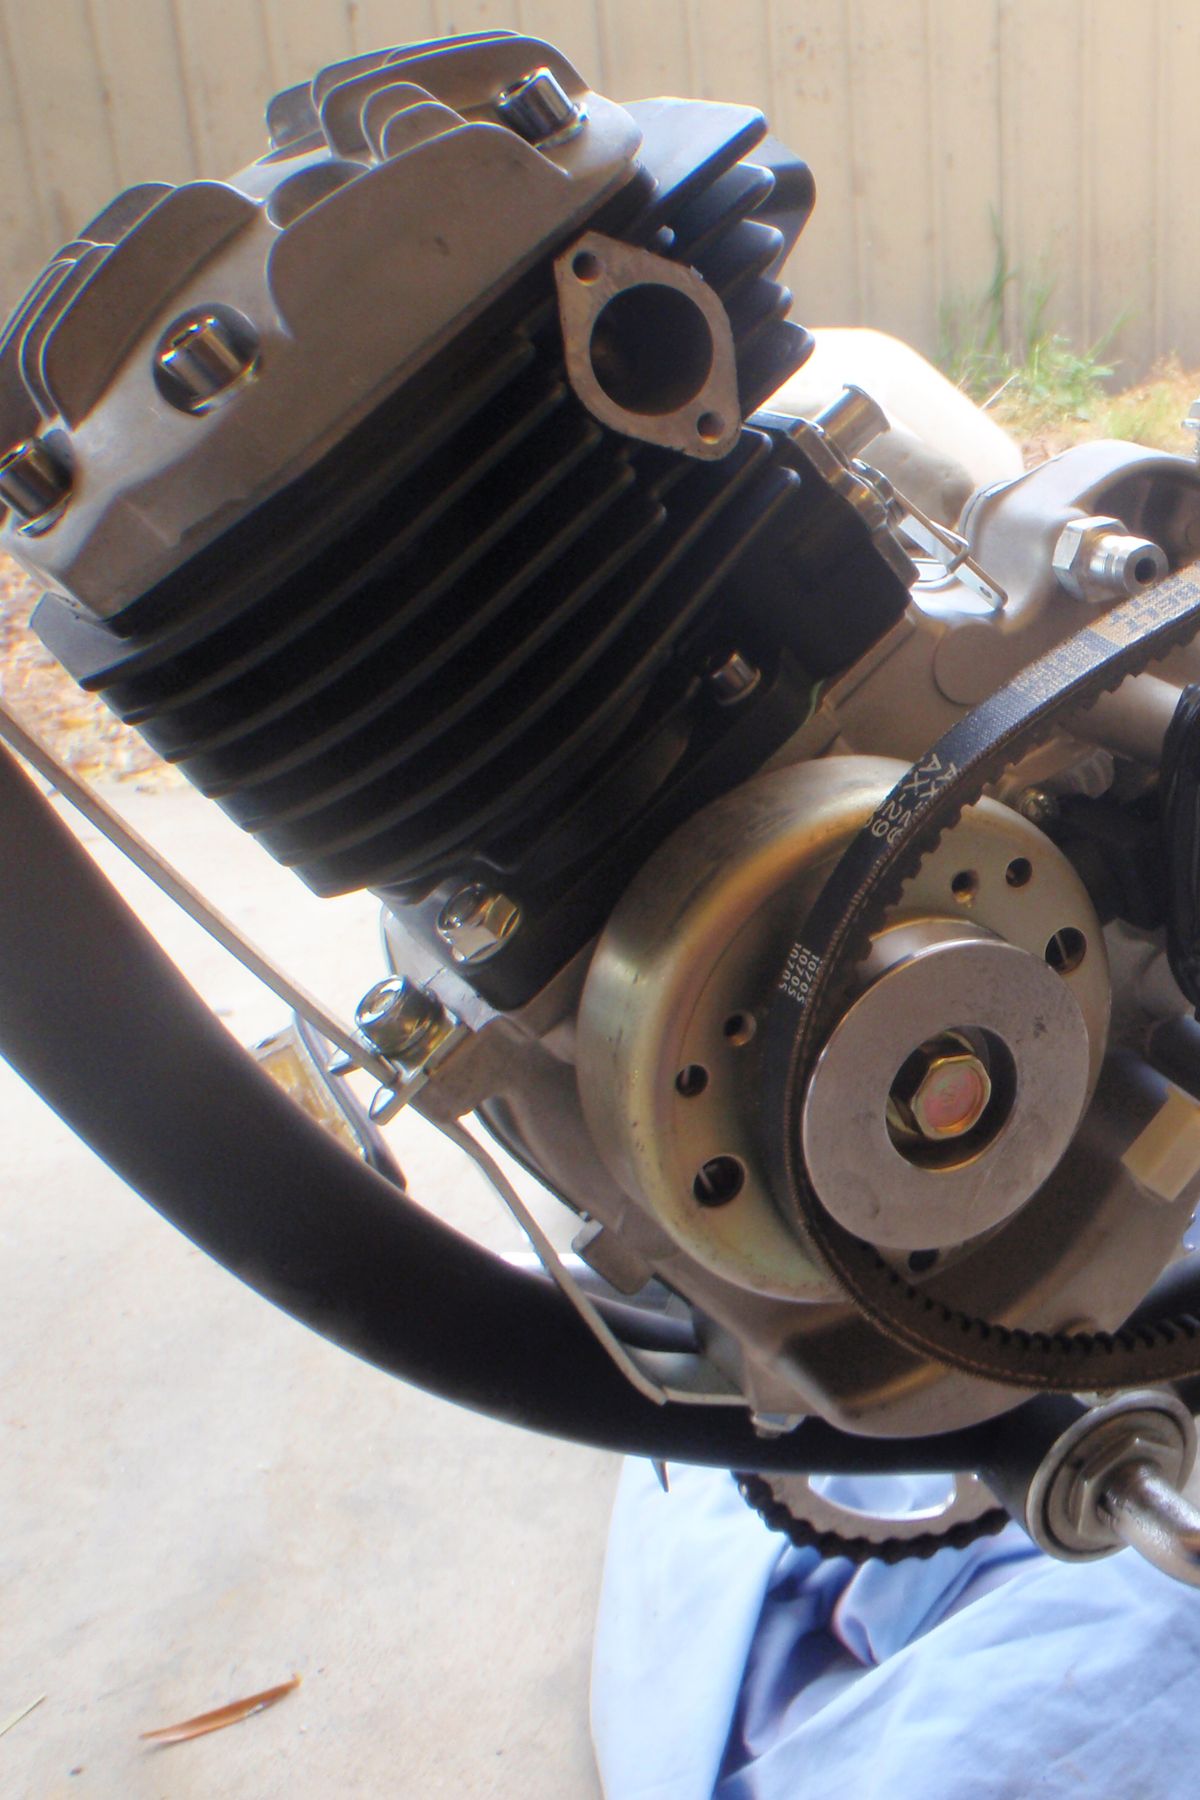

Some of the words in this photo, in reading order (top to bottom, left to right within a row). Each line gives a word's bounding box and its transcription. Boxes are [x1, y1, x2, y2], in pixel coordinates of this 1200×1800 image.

[1124, 580, 1200, 633] BELT
[871, 753, 942, 838] AX-29
[787, 948, 811, 997] 10705
[796, 954, 820, 1003] 10705
